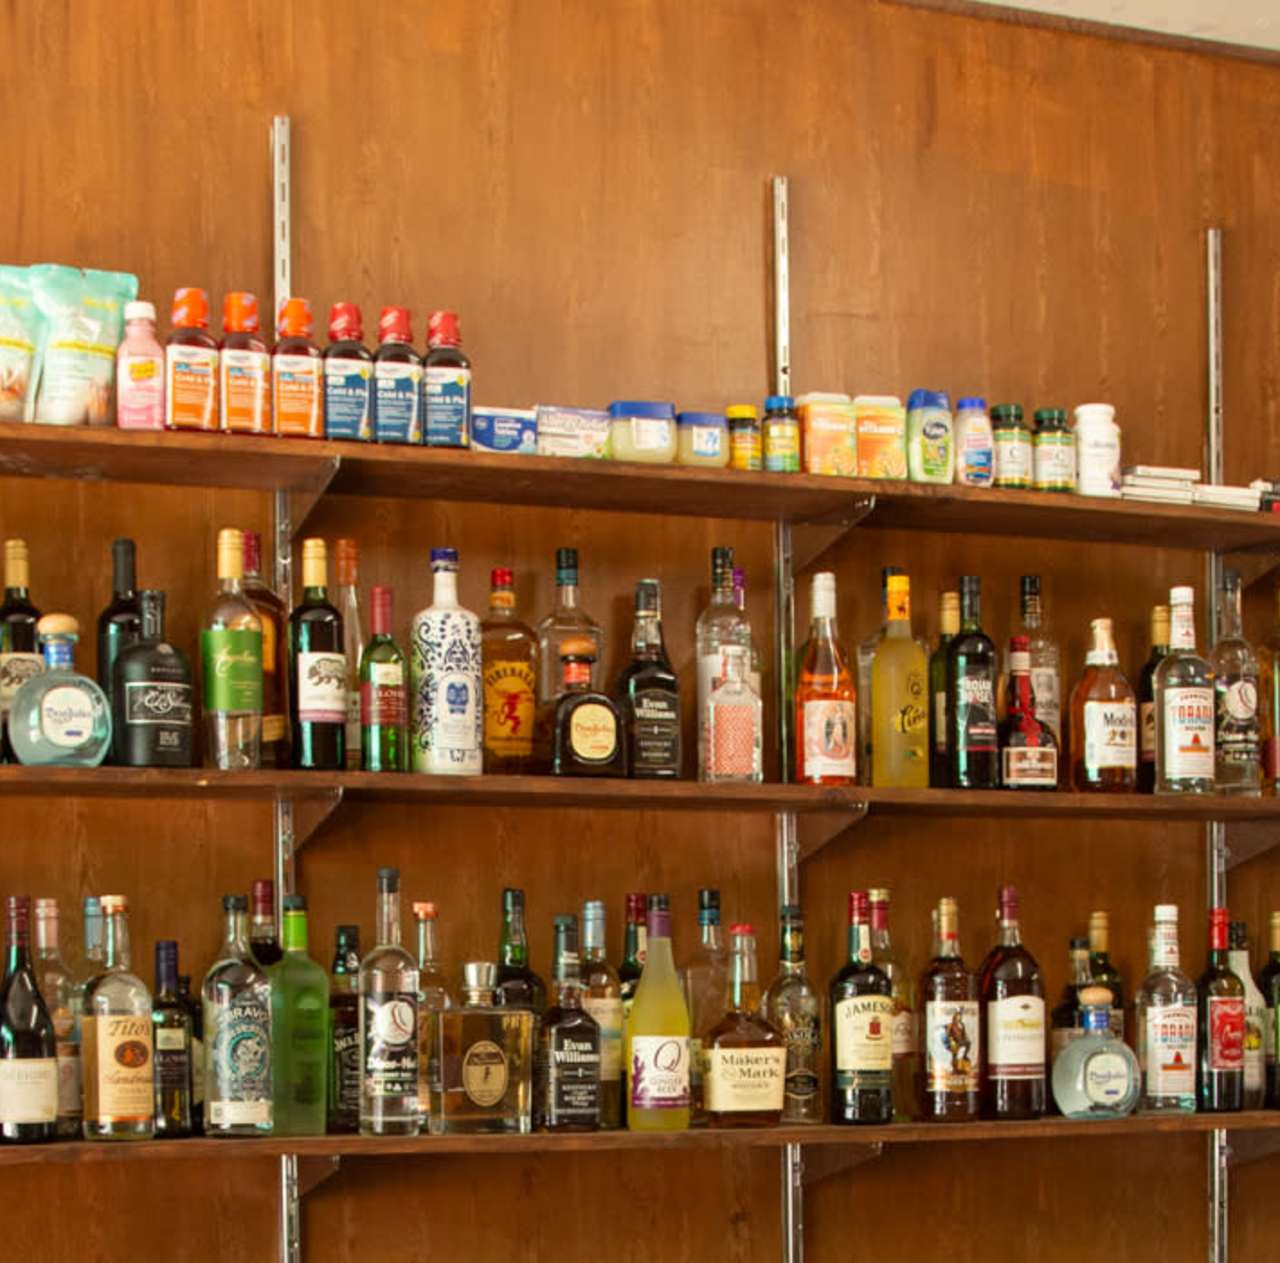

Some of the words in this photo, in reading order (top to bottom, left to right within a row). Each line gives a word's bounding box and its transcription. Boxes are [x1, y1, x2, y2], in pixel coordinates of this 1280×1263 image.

[563, 1038, 593, 1052] Evan
[653, 1039, 683, 1074] Q
[738, 1065, 781, 1080] Mark
